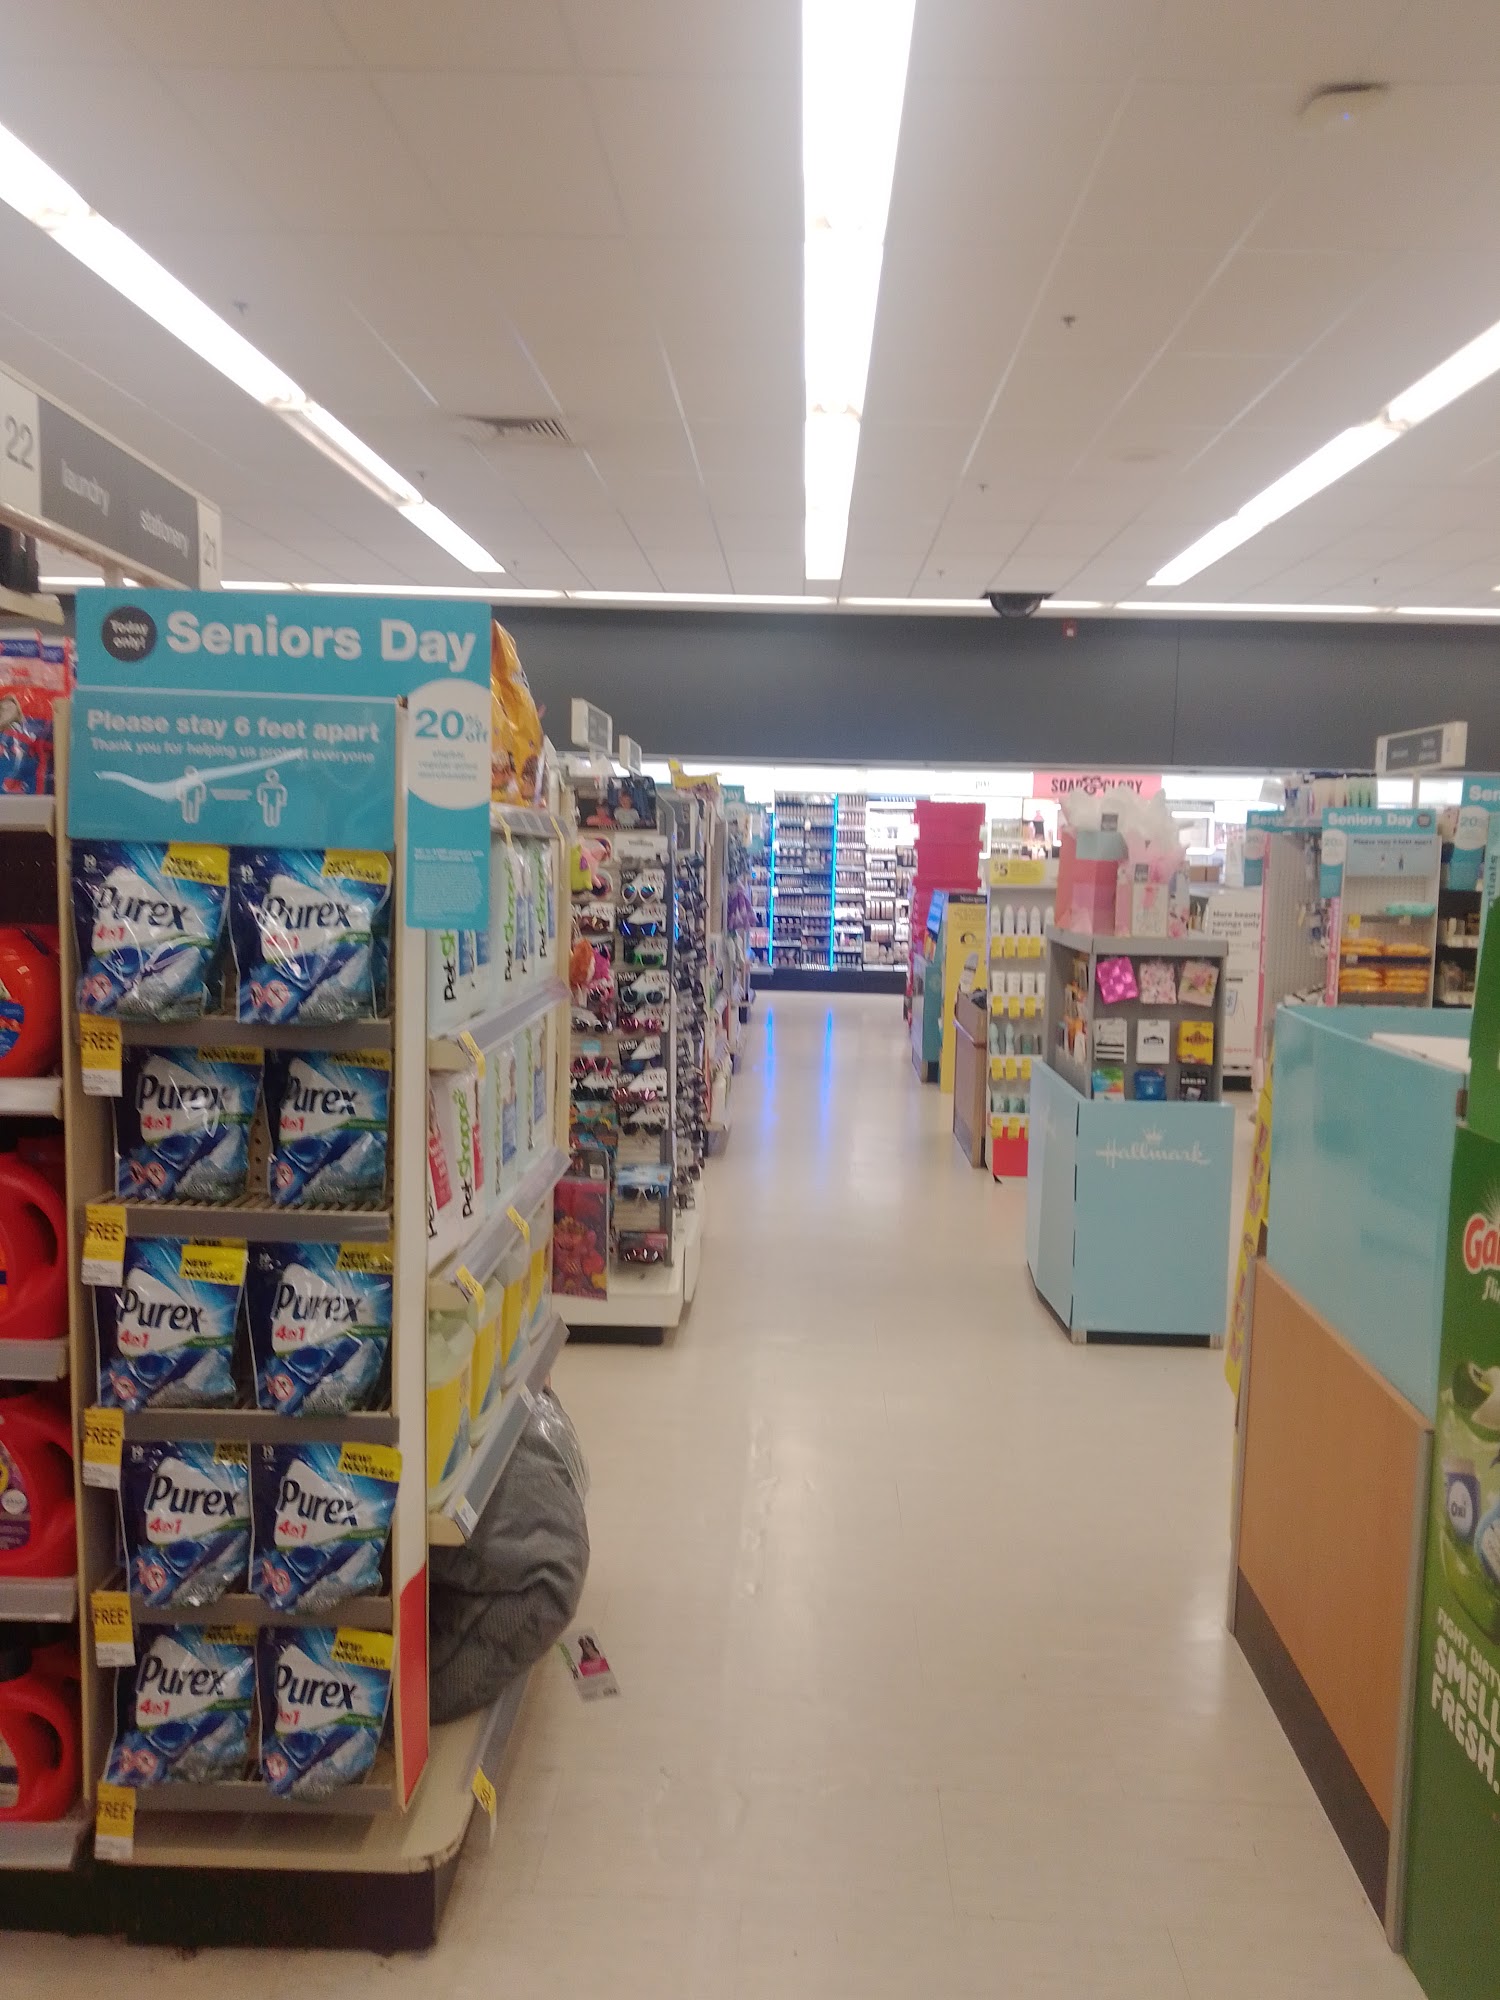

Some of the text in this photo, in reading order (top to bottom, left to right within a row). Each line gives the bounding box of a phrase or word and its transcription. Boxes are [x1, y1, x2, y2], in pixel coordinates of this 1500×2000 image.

[4, 414, 36, 472] 22
[110, 619, 149, 638] Today
[166, 610, 477, 673] Seniors Day
[86, 708, 380, 744] Please stay 6 feet apart
[464, 728, 489, 745] off
[91, 737, 133, 752] Thank
[136, 740, 161, 756] you
[163, 740, 183, 755] for
[186, 741, 238, 760] helping
[313, 749, 375, 765] everyone
[1327, 811, 1383, 826] Seniors
[1386, 812, 1414, 828] Day
[97, 885, 189, 931] Purex
[258, 896, 351, 930] Purex
[443, 958, 458, 1003] Pet
[138, 1075, 228, 1114] Purex
[280, 1076, 358, 1115] Purex
[1096, 1137, 1212, 1169] Hallmark
[461, 1176, 474, 1219] Pet
[1464, 1212, 1500, 1275] Ga
[117, 1288, 203, 1333] Purex
[273, 1283, 363, 1323] Purex
[147, 1474, 239, 1517] Purex
[279, 1479, 359, 1527] Purex
[1437, 1606, 1500, 1698] FIGHT DIRT
[138, 1655, 226, 1697] Purex
[276, 1664, 358, 1711] Purex
[1434, 1634, 1500, 1747] SMELL
[1431, 1671, 1500, 1795] FRESH.
